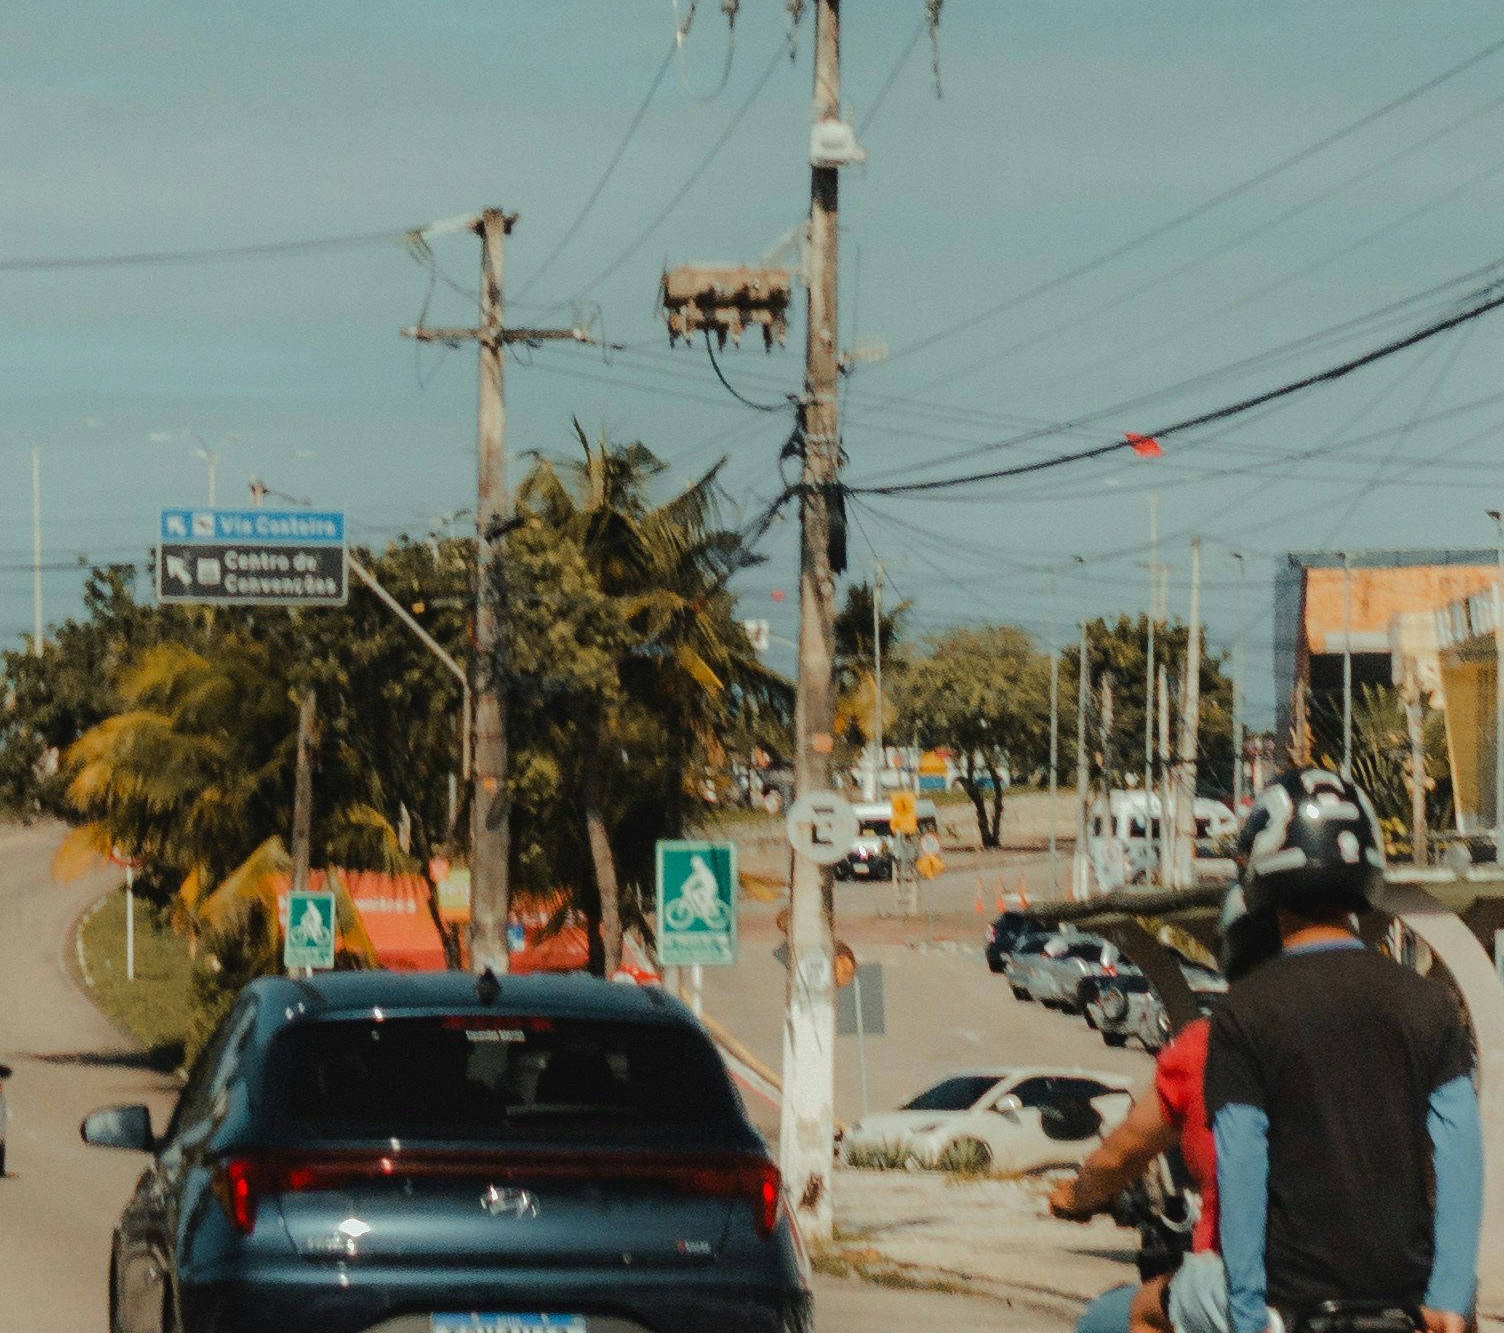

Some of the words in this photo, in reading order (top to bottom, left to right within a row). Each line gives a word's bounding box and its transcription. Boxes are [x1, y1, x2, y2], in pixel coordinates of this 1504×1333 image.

[221, 515, 252, 534] Via
[256, 515, 335, 535] Costeira
[224, 550, 289, 571] Centro
[293, 551, 317, 572] de
[224, 574, 336, 594] Convenções
